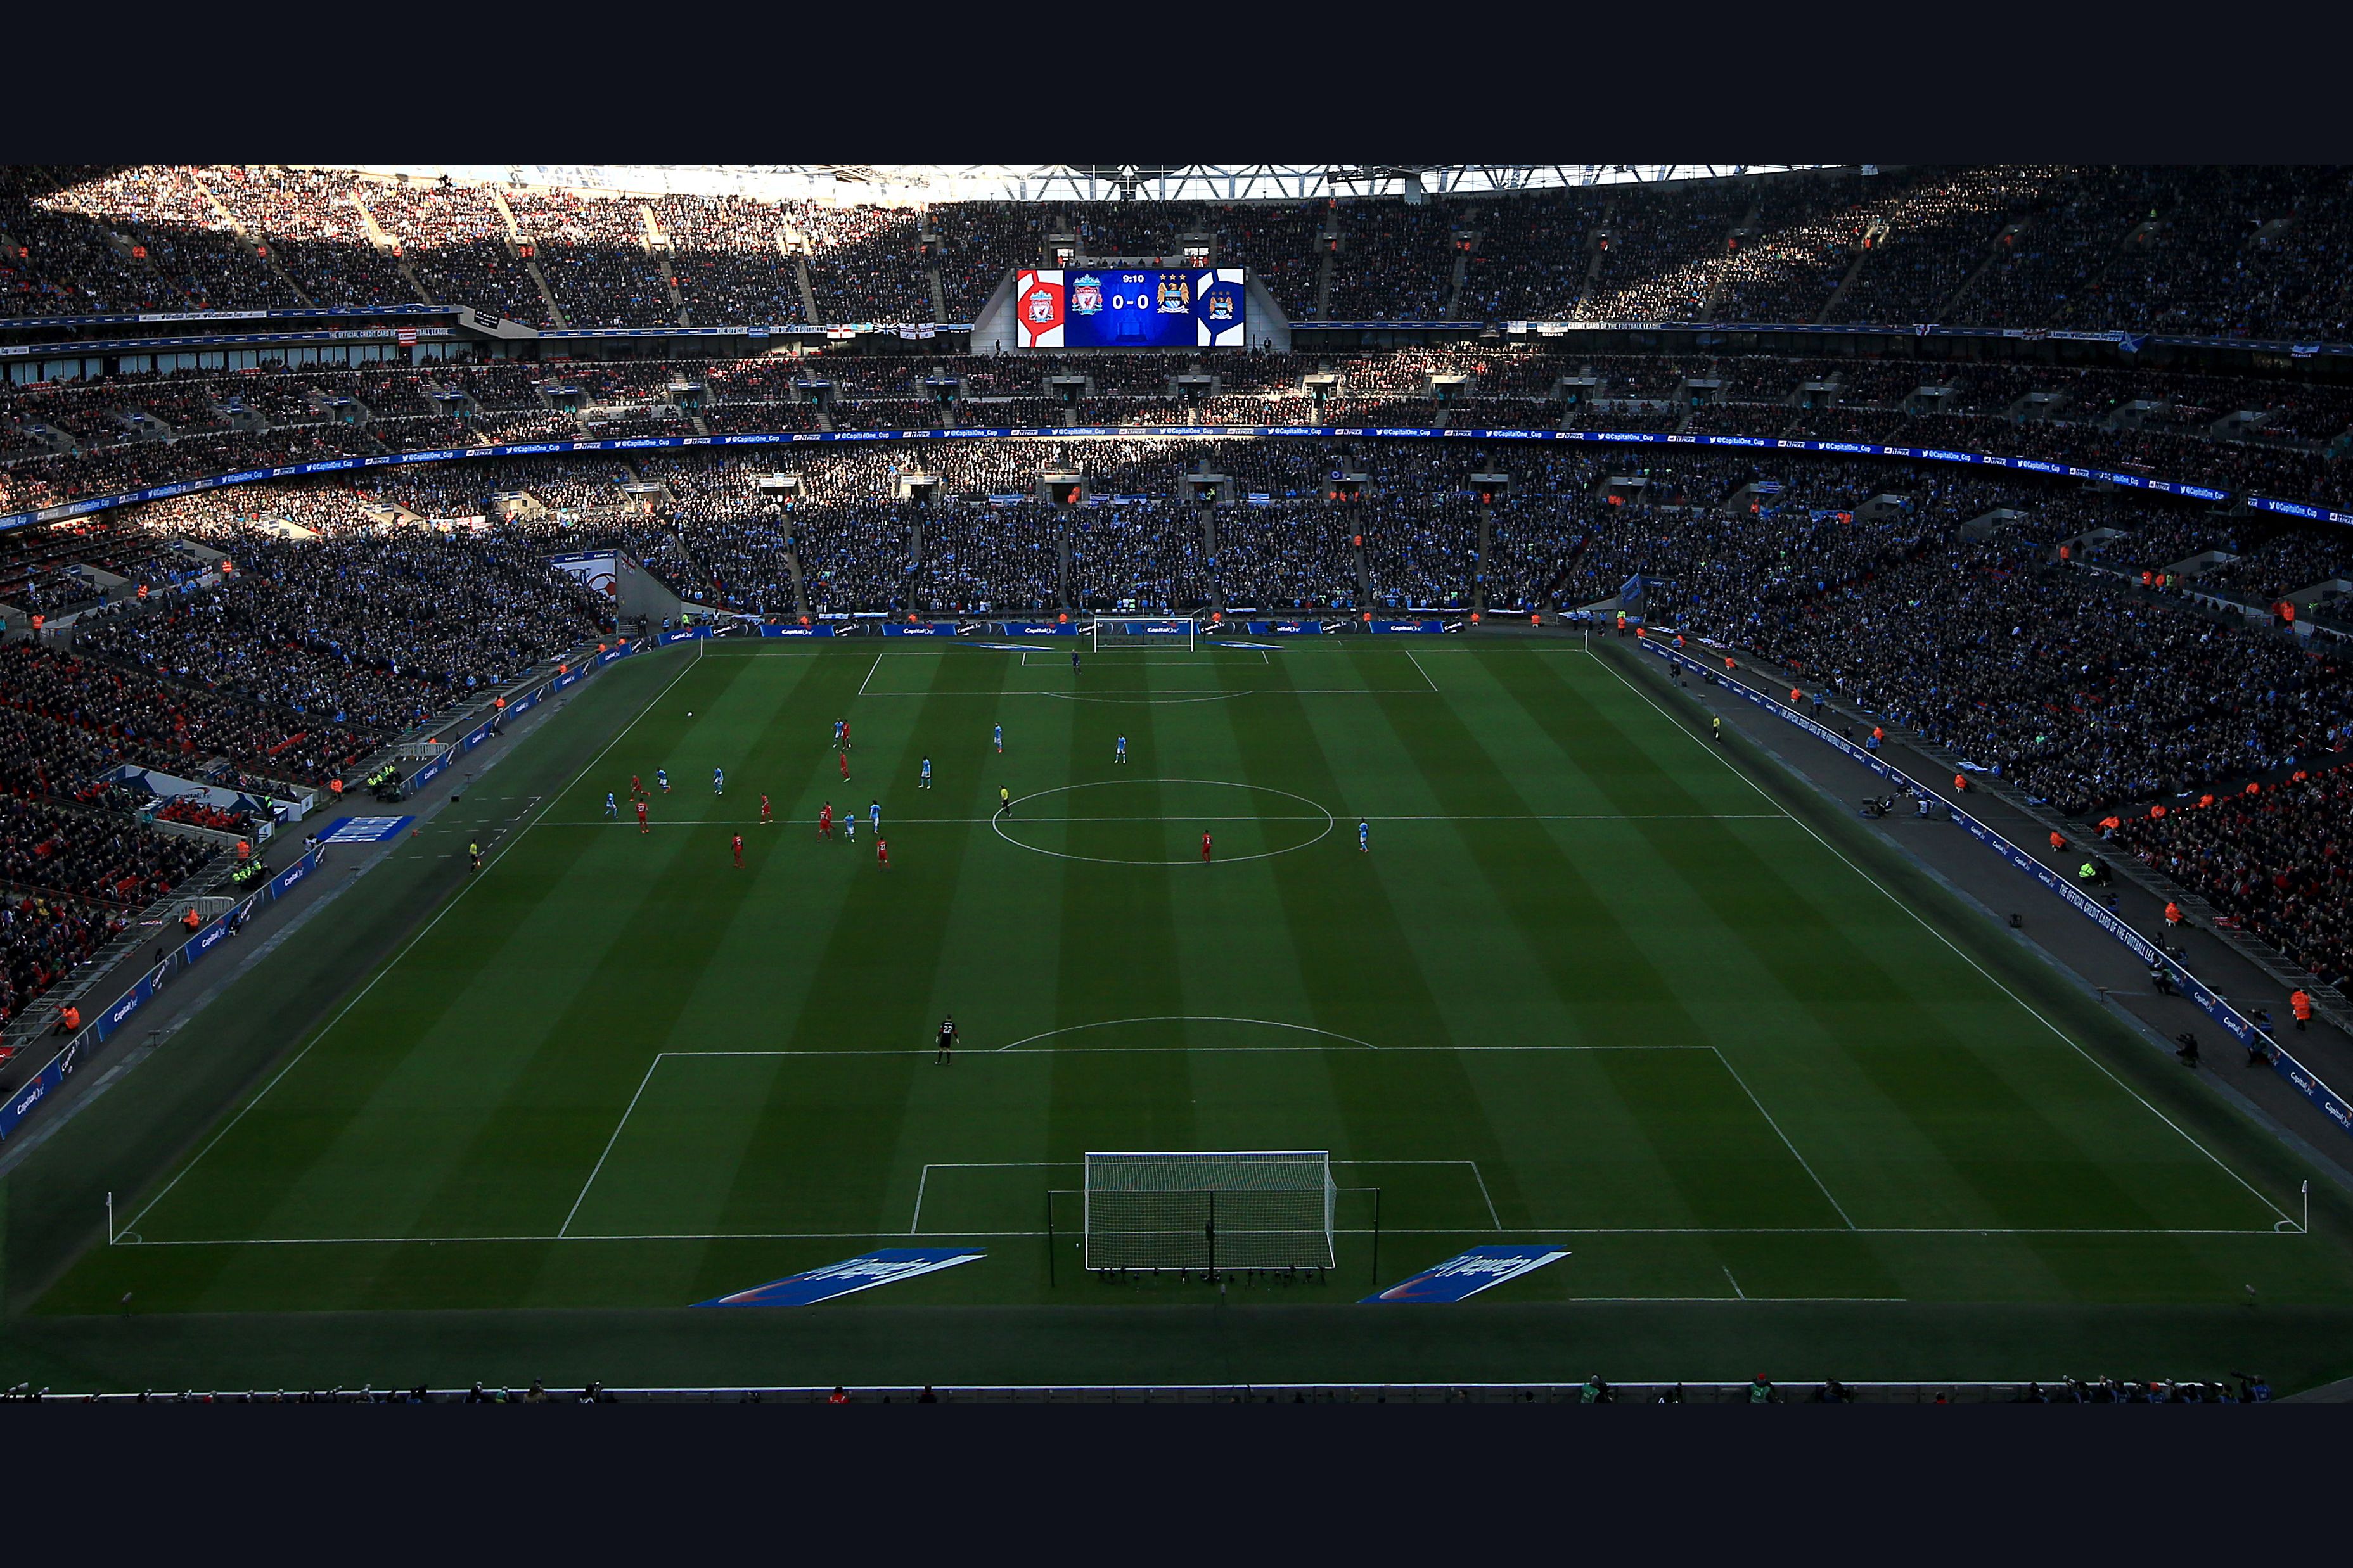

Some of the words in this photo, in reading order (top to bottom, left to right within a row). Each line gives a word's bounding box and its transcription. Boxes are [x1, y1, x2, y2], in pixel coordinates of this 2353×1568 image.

[1123, 274, 1144, 283] 9:10
[2058, 884, 2068, 897] THE
[2067, 889, 2085, 910] OFFICIAL
[2083, 902, 2100, 920] CREDIT
[2098, 912, 2112, 929] CARD
[2110, 921, 2118, 933] OF
[2116, 925, 2126, 940] THE
[2124, 932, 2146, 957] FOOTBALL
